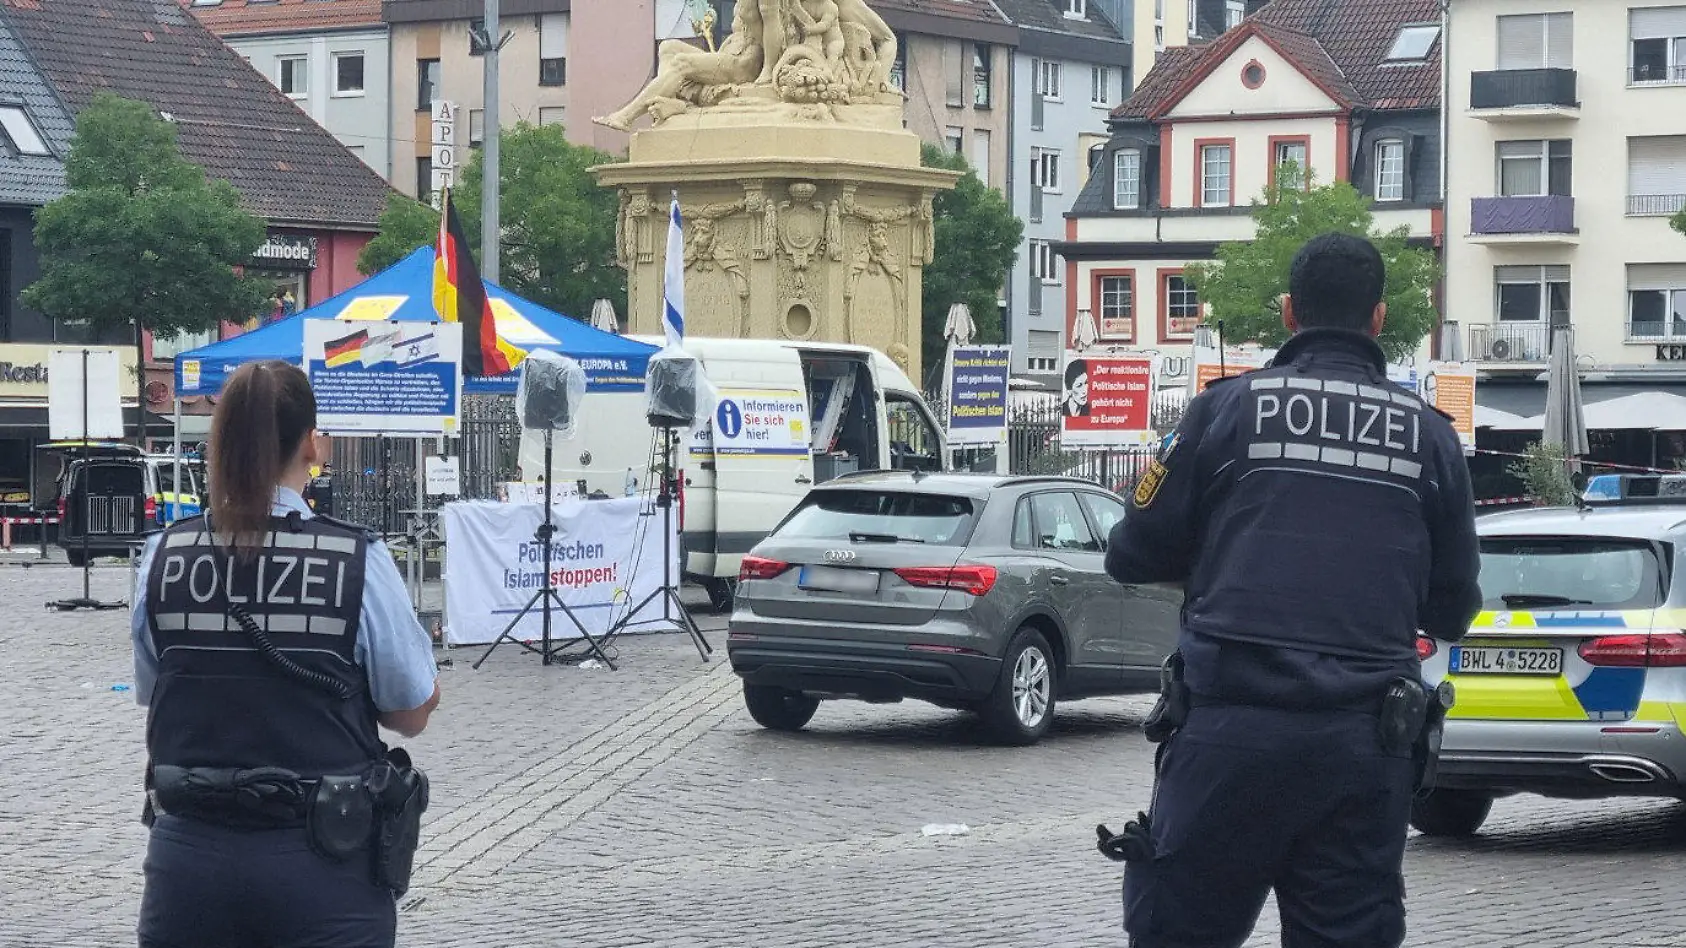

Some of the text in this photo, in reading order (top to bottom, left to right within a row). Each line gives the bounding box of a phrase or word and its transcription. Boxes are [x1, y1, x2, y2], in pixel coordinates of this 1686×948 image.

[582, 359, 612, 370] EUROPA
[1110, 366, 1149, 374] reaktionäre
[1092, 381, 1146, 390] Politische Islam
[743, 400, 804, 412] Informieren
[1092, 398, 1133, 408] gehört nicht
[952, 405, 1004, 416] Politischen Islam
[744, 414, 784, 426] Sie sich
[1256, 394, 1420, 453] POLIZEI
[746, 428, 768, 440] hier!
[160, 554, 345, 608] POLIZEI
[504, 562, 617, 588] Islam stoppen!
[1461, 650, 1491, 668] BWL
[1496, 651, 1504, 669] 4
[1518, 652, 1558, 670] 5228
